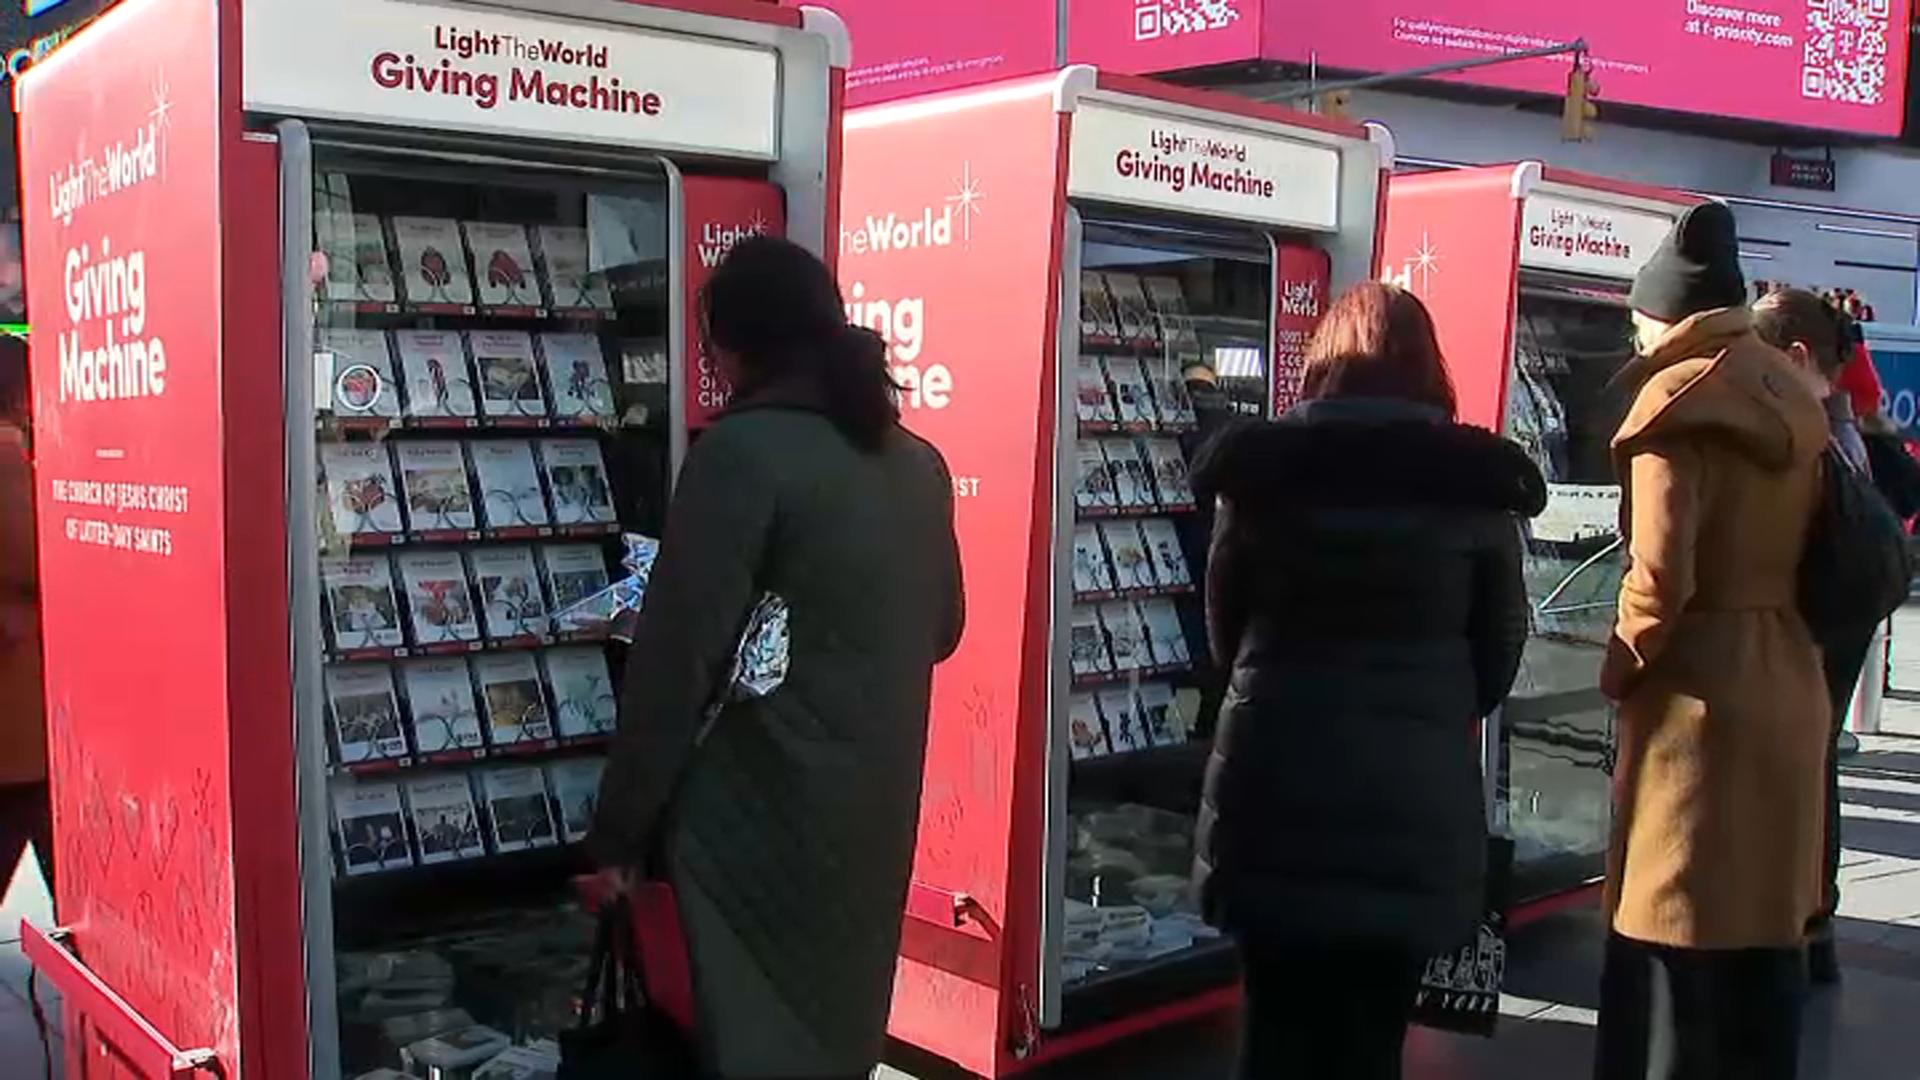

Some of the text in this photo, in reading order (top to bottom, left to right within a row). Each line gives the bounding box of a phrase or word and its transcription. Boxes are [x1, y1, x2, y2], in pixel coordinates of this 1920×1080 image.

[434, 25, 608, 69] LightTheWorld
[371, 51, 662, 116] Giving Machine
[1150, 130, 1246, 163] LightTheWorld
[49, 123, 156, 227] LightTheWorld
[1116, 149, 1274, 198] Giving Machine
[840, 205, 952, 256] heWorld
[1529, 226, 1631, 259] Giving Machine
[65, 235, 145, 335] Giving
[58, 317, 166, 403] Machine
[52, 479, 188, 513] THE CHURCH OF JESUS CHRIST
